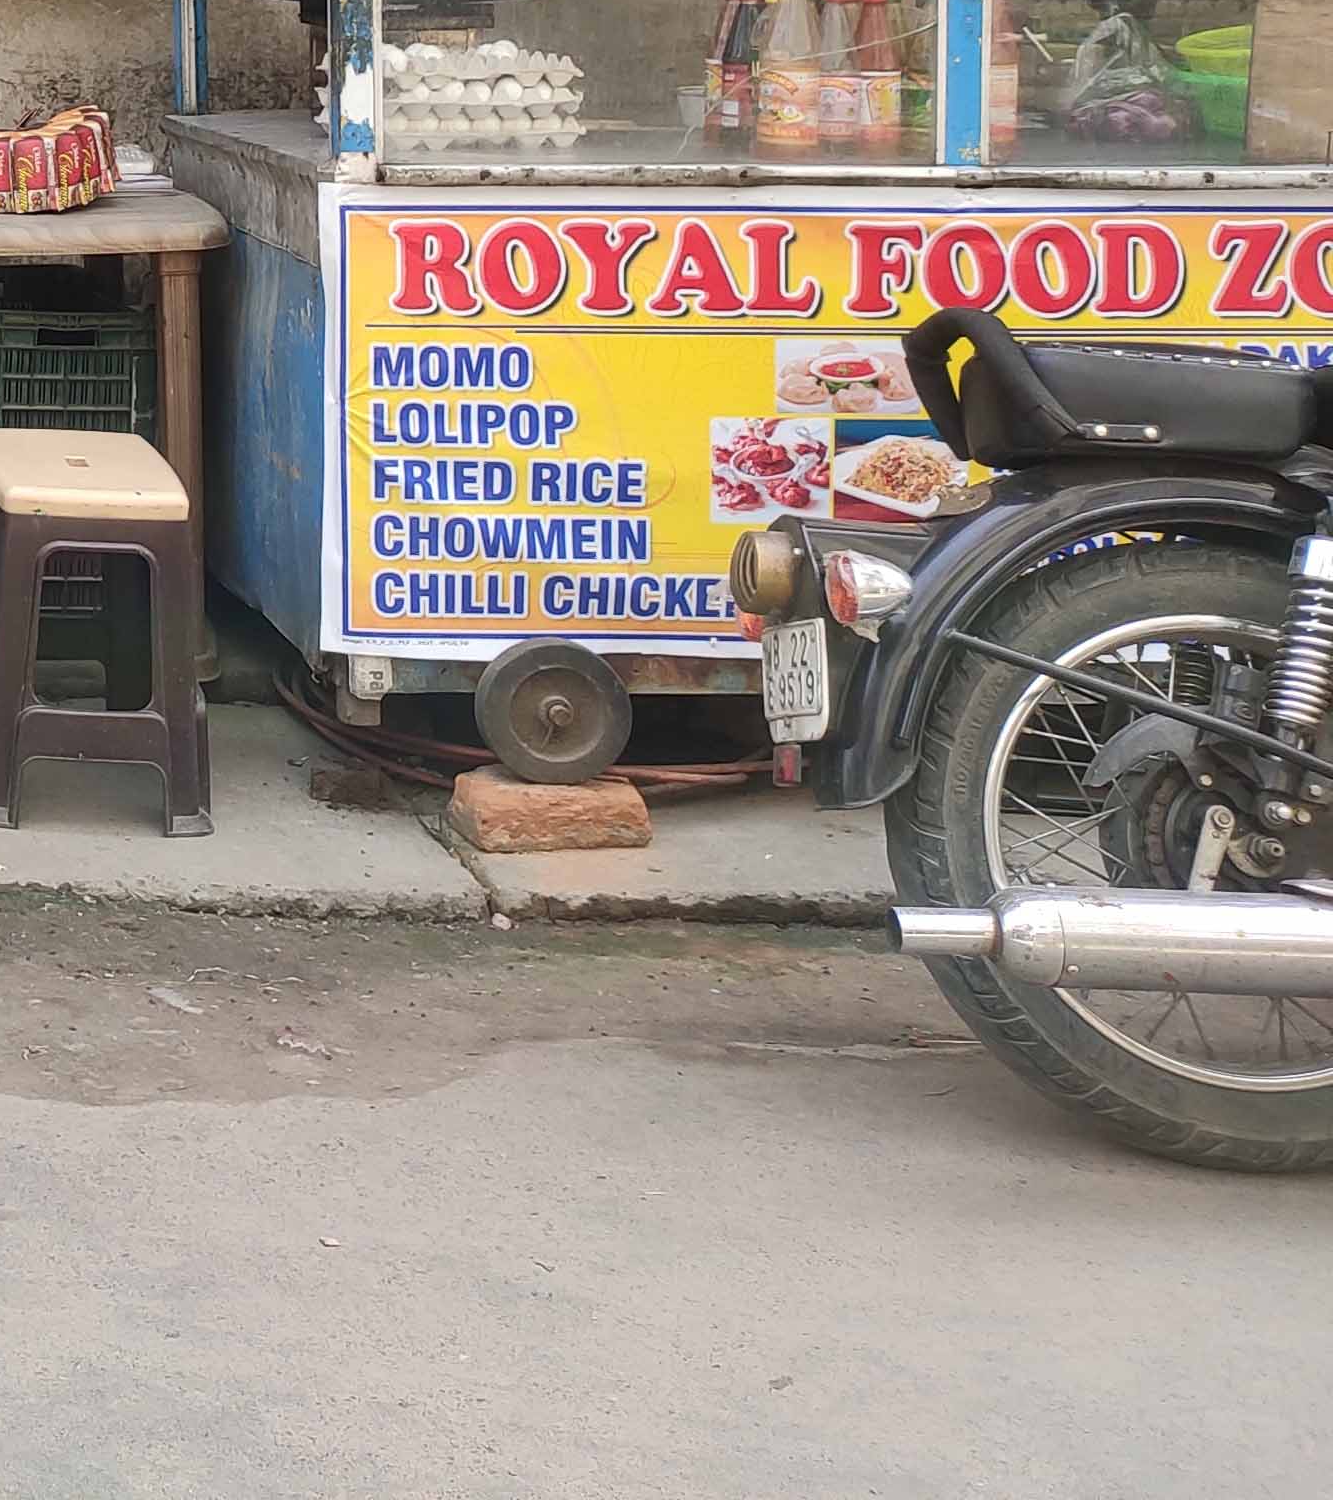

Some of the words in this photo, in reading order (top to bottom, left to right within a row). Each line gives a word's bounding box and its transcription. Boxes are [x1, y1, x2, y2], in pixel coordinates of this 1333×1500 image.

[391, 220, 818, 314] ROYAL
[847, 221, 1181, 315] FOOD
[372, 344, 531, 390] MOMO
[372, 401, 576, 448] LOLIPOP
[372, 458, 514, 503] FRIED
[530, 460, 645, 506] RICE
[372, 514, 649, 562] CHOWMEIN
[372, 571, 527, 617] CHILLI
[542, 575, 733, 619] CHICKE
[790, 630, 808, 668] 22
[779, 669, 816, 709] 9519
